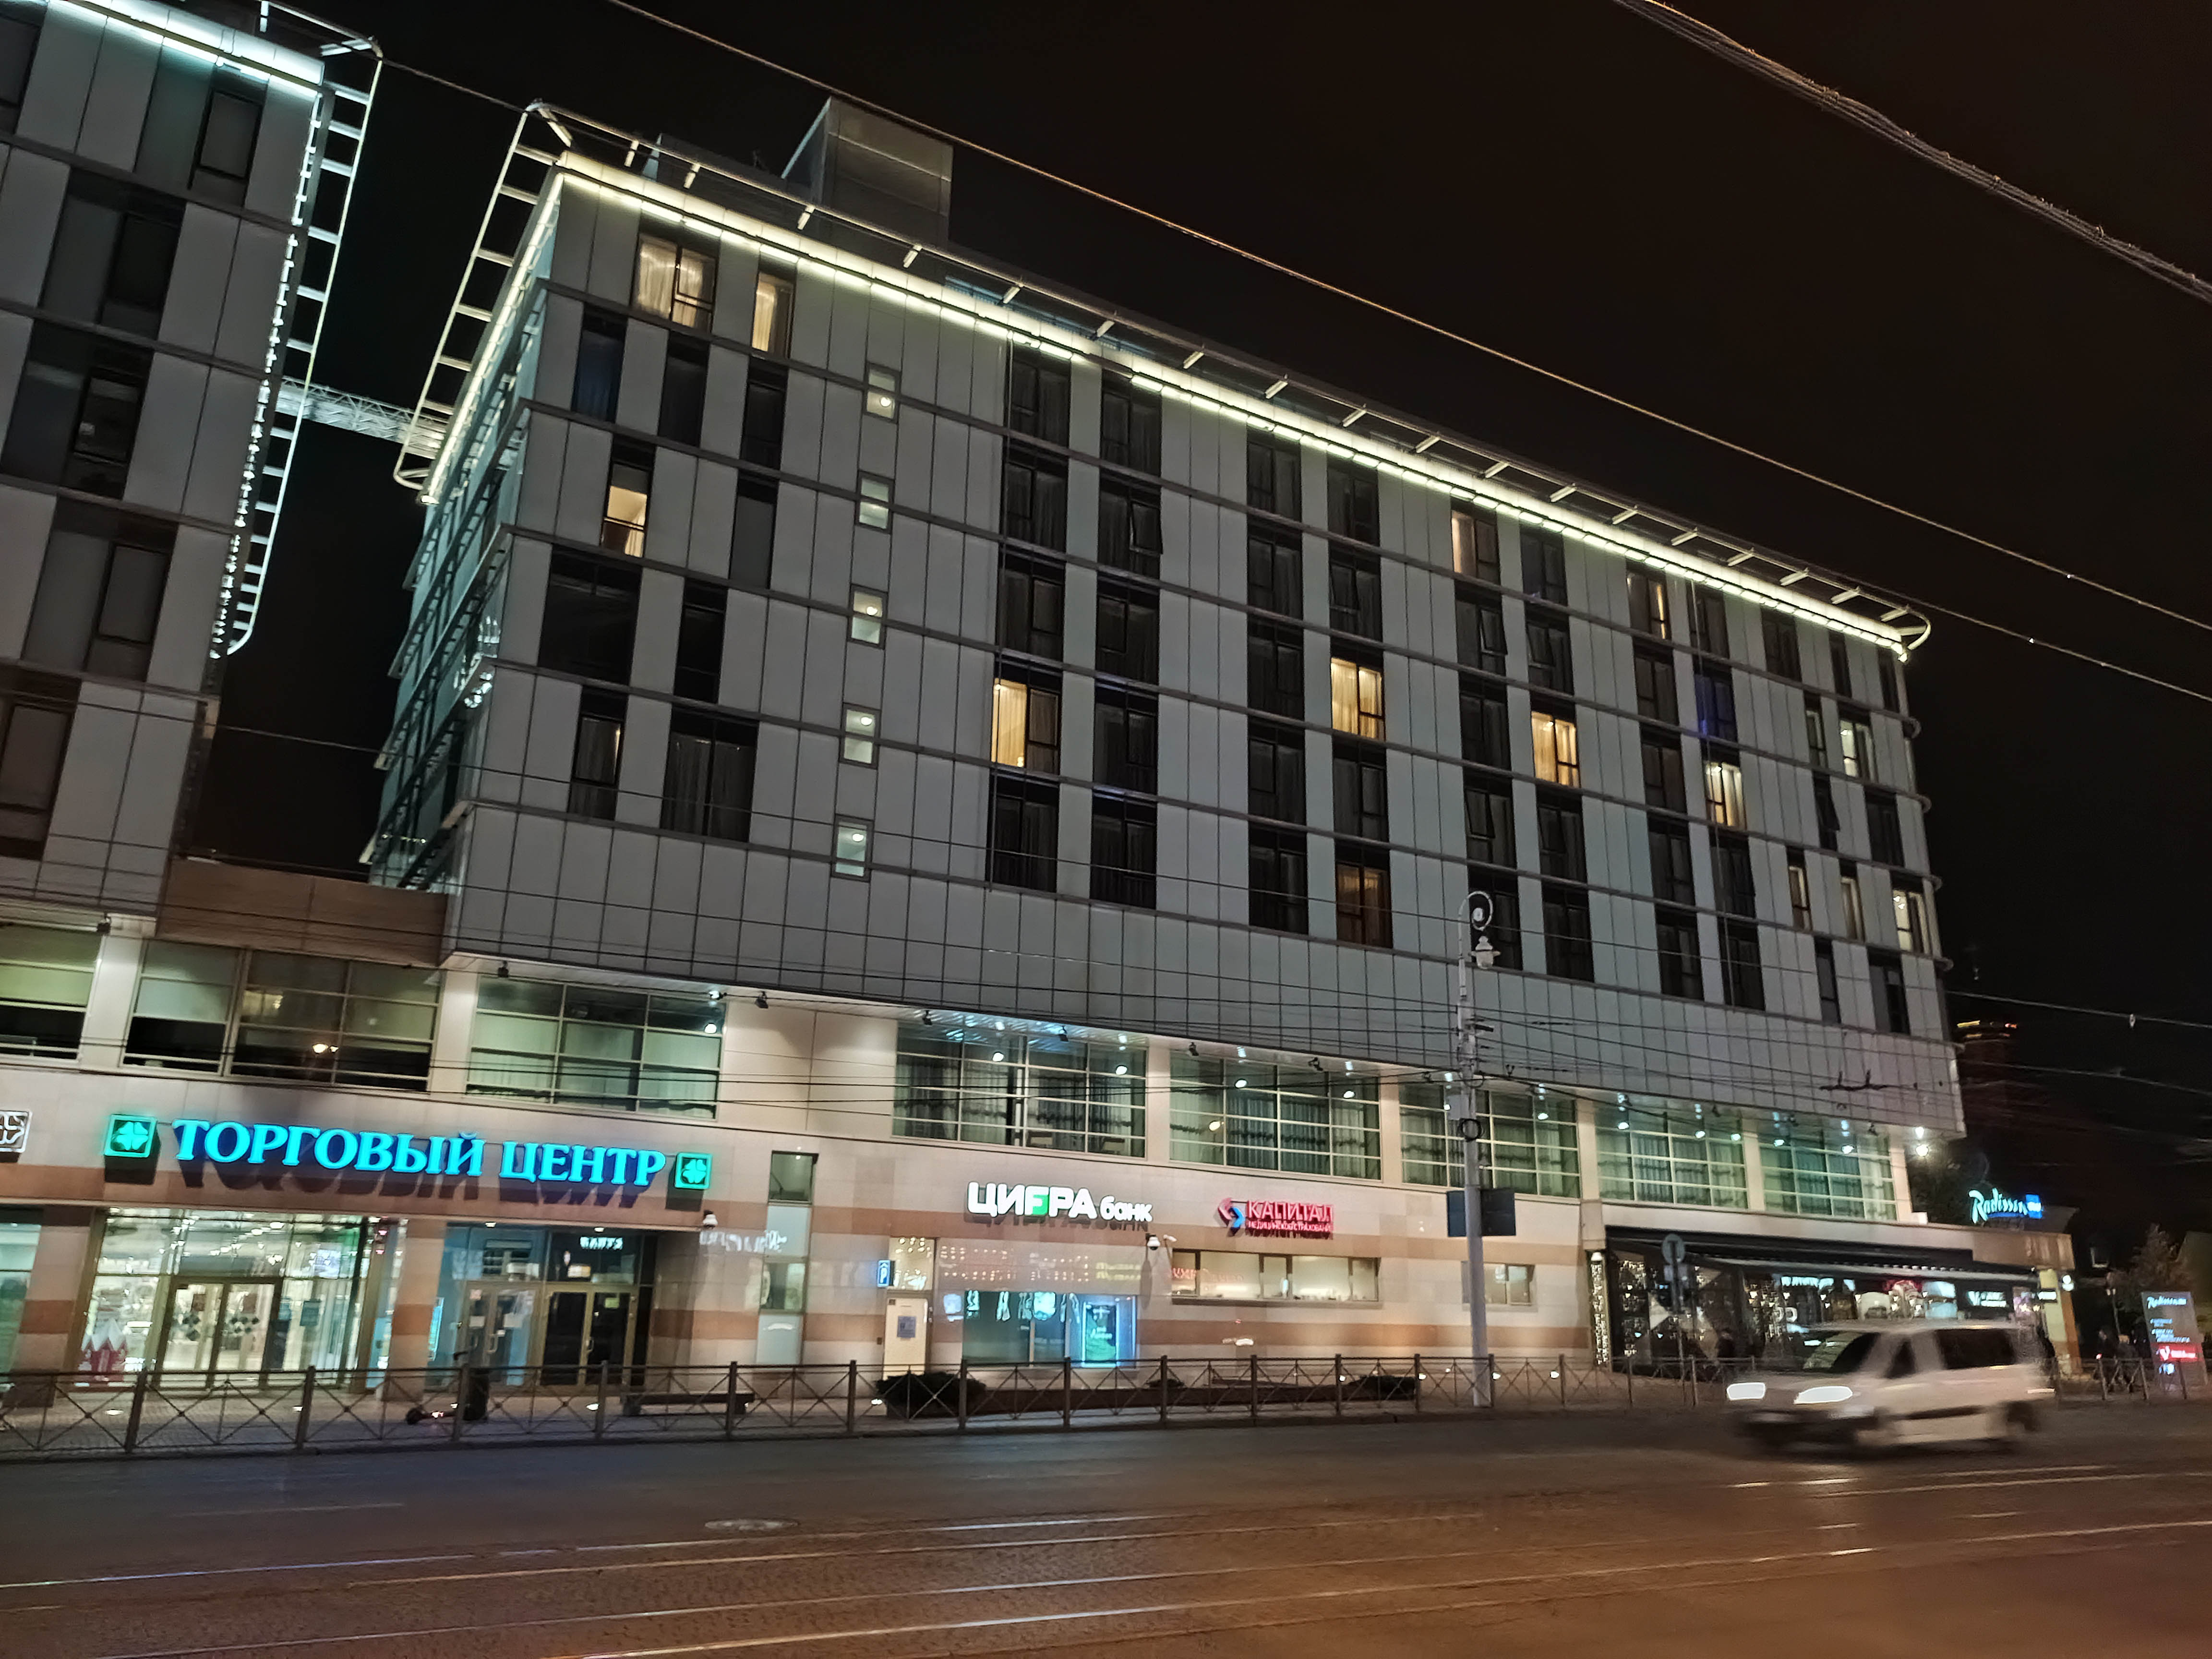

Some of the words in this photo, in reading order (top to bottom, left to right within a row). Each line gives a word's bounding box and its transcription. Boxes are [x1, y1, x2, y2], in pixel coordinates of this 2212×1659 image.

[172, 1119, 486, 1176] ТОРГОВЫЙ
[498, 1141, 666, 1186] ЦЕНТР
[1100, 1195, 1153, 1222] банк
[1246, 1200, 1333, 1222] КАПИТАЛ
[1969, 1188, 2028, 1224] Radisson
[879, 1267, 888, 1283] P
